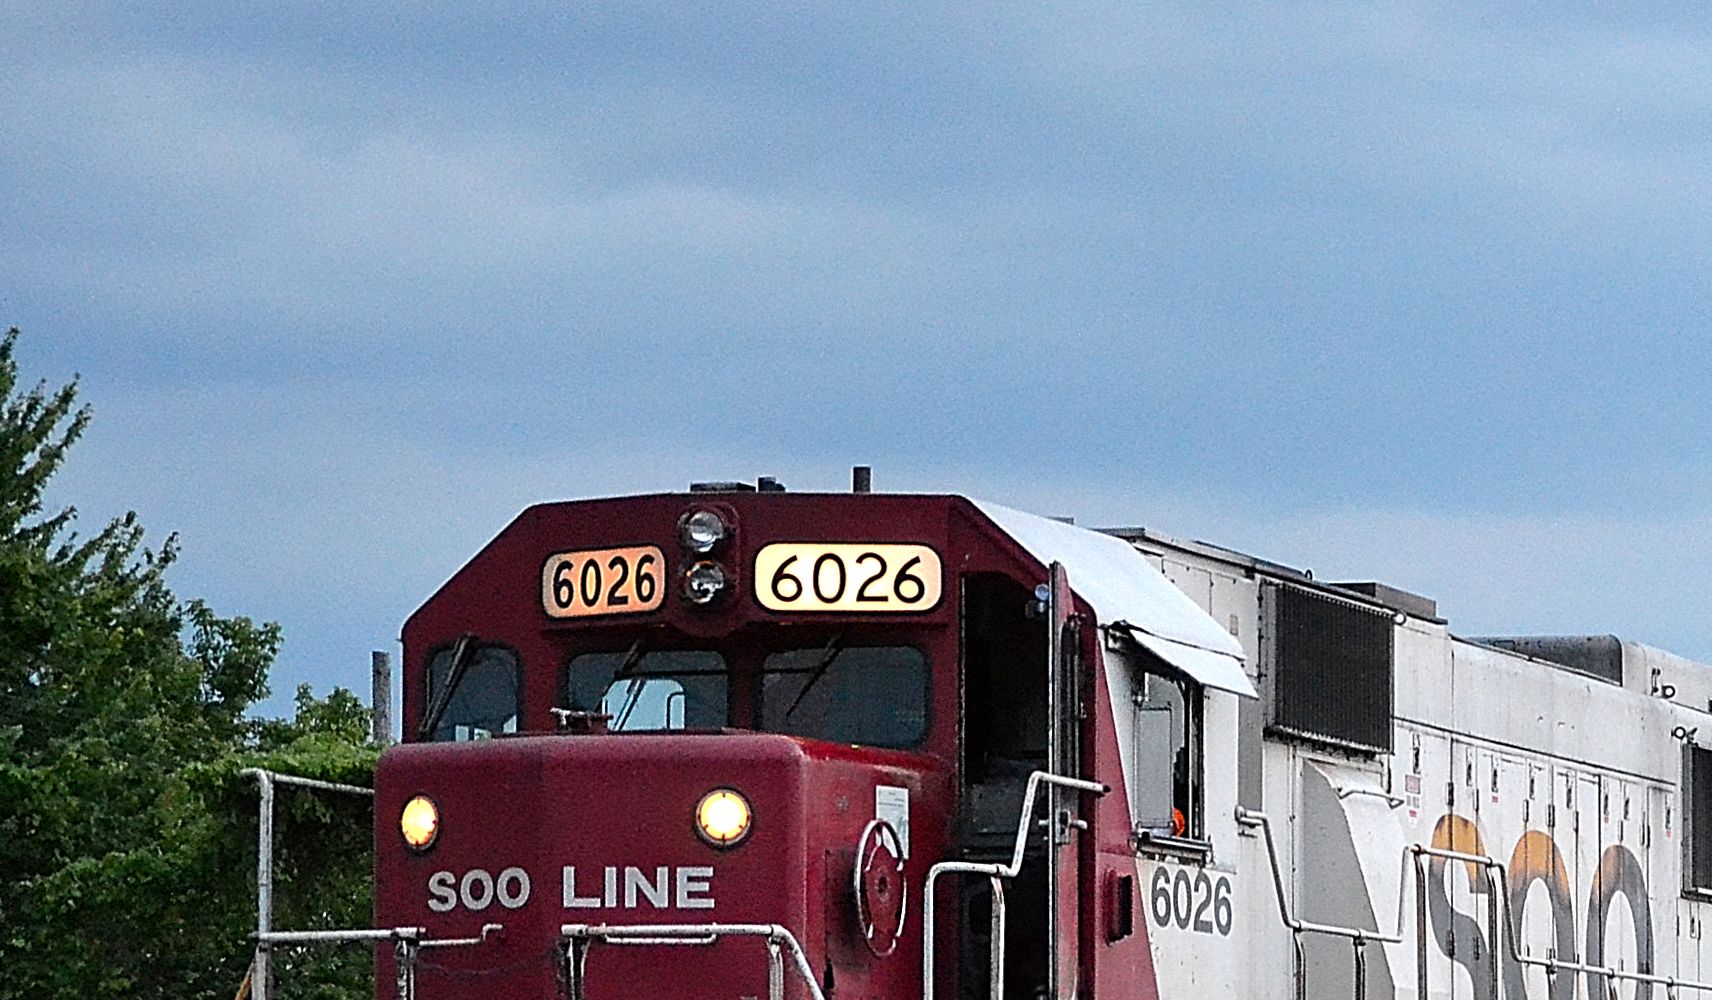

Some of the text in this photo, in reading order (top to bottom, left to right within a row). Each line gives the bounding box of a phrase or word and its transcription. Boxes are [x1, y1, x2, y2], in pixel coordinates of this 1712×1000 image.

[552, 553, 656, 610] 6026
[771, 552, 927, 604] 6026
[428, 866, 715, 912] SOO LINE
[1151, 866, 1232, 936] 6026
